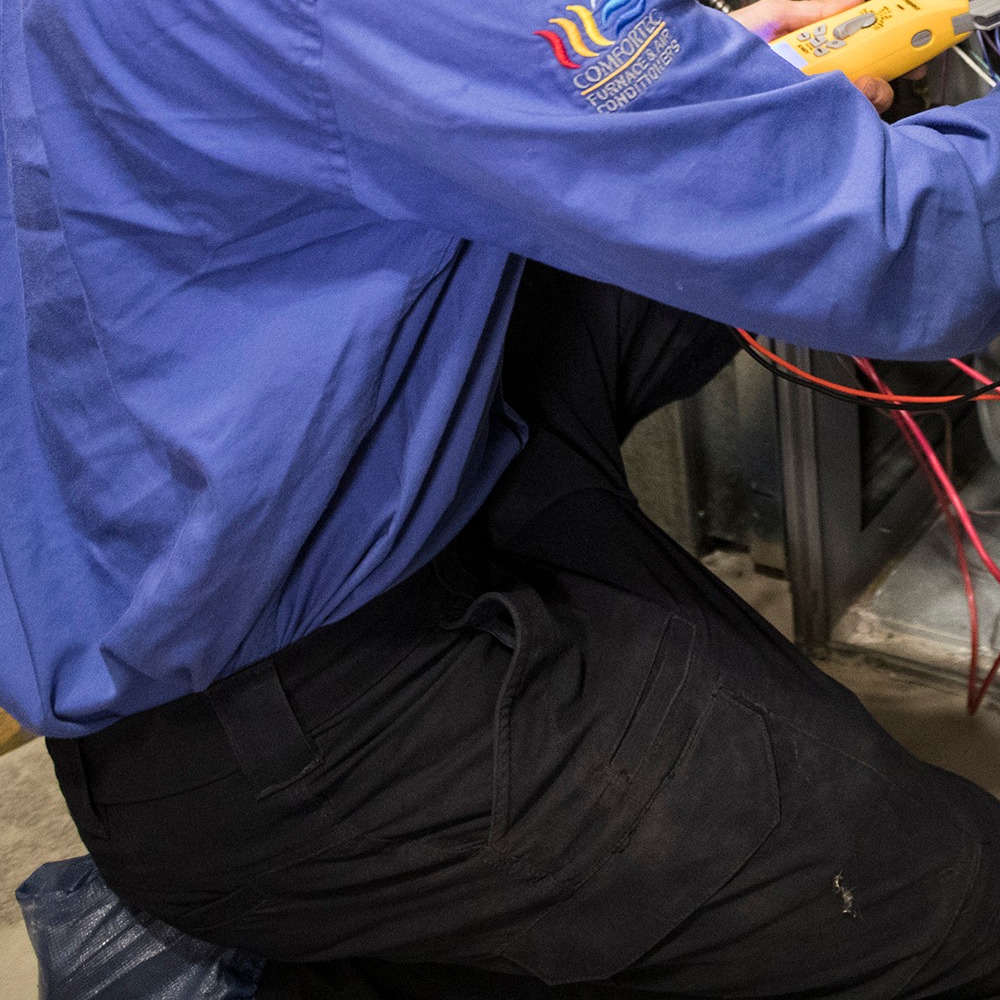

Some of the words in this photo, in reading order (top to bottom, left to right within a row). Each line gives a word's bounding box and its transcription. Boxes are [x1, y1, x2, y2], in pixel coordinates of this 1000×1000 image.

[573, 8, 662, 89] COMFORTEC
[586, 56, 650, 107] FURNACE
[652, 28, 671, 53] AIR
[597, 39, 682, 114] CONDITIONERS
